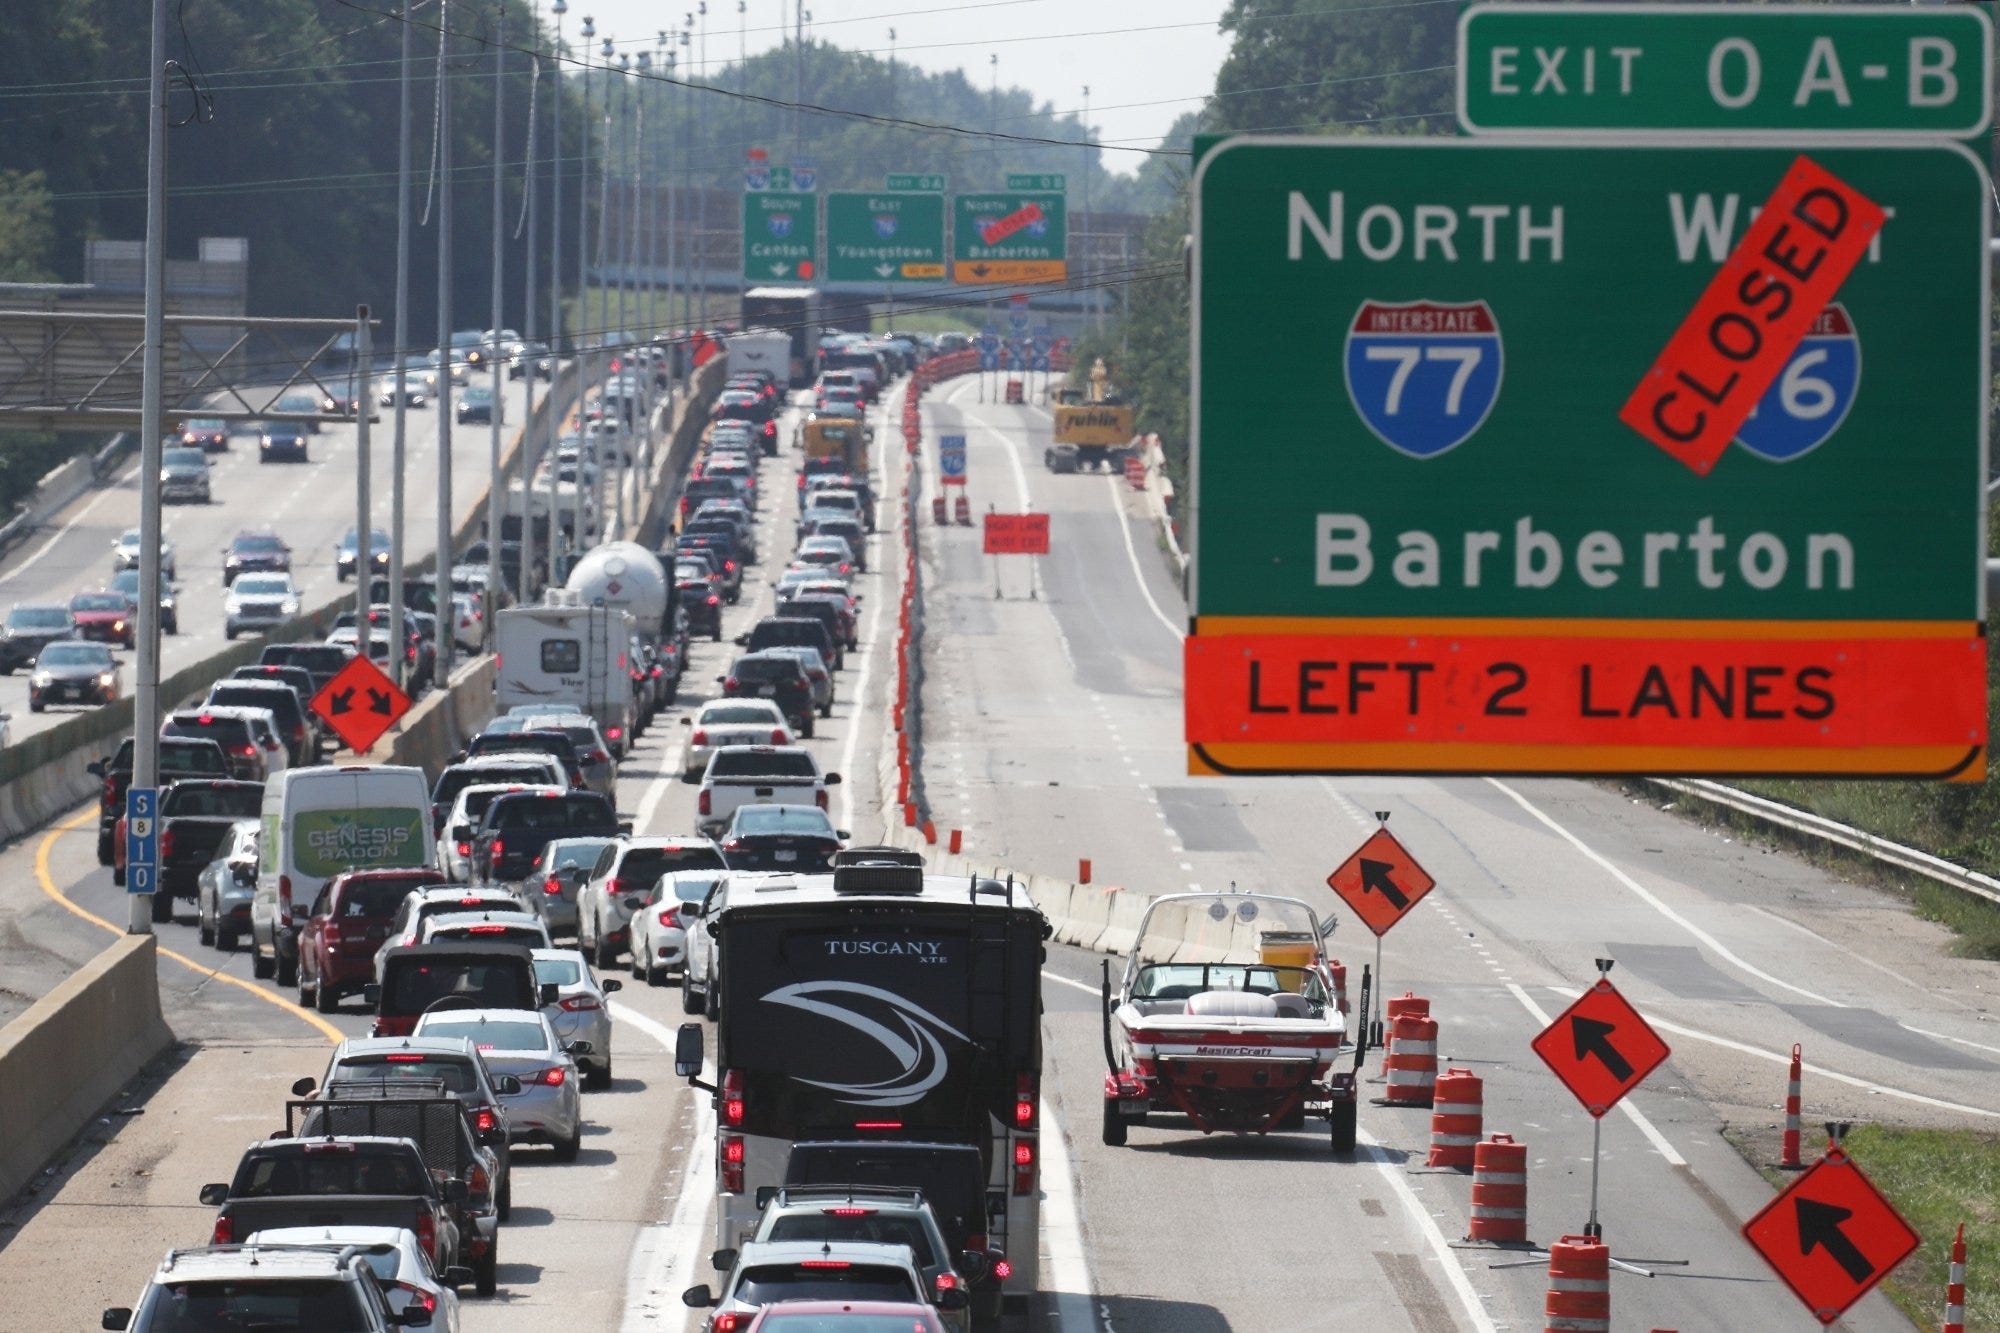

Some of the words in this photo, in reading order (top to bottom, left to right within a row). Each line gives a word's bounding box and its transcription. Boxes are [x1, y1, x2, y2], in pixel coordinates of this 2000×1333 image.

[1491, 46, 1643, 96] EXIT
[1794, 36, 1960, 107] A-B
[1287, 191, 1565, 263] NORTH
[751, 243, 810, 257] Canton
[836, 246, 934, 260] Youngstown
[969, 246, 1050, 258] Barberton
[1370, 310, 1478, 332] INTERSTATE
[1650, 187, 1850, 445] CLOSED
[1365, 346, 1483, 416] 77
[1746, 349, 1837, 420] 6
[1314, 513, 1856, 589] Barberton
[1248, 660, 1436, 716] LEFT
[1484, 662, 1529, 717] 2
[1580, 663, 1838, 721] LANES
[136, 795, 148, 814] S
[137, 821, 146, 834] 8
[308, 826, 410, 847] GENESIS
[138, 841, 144, 861] 1
[318, 846, 399, 862] RADON
[135, 868, 147, 888] 0
[825, 941, 942, 955] TUSCANY
[1361, 988, 1369, 1031] MasterCraft
[1196, 1046, 1272, 1057] MasterCraft
